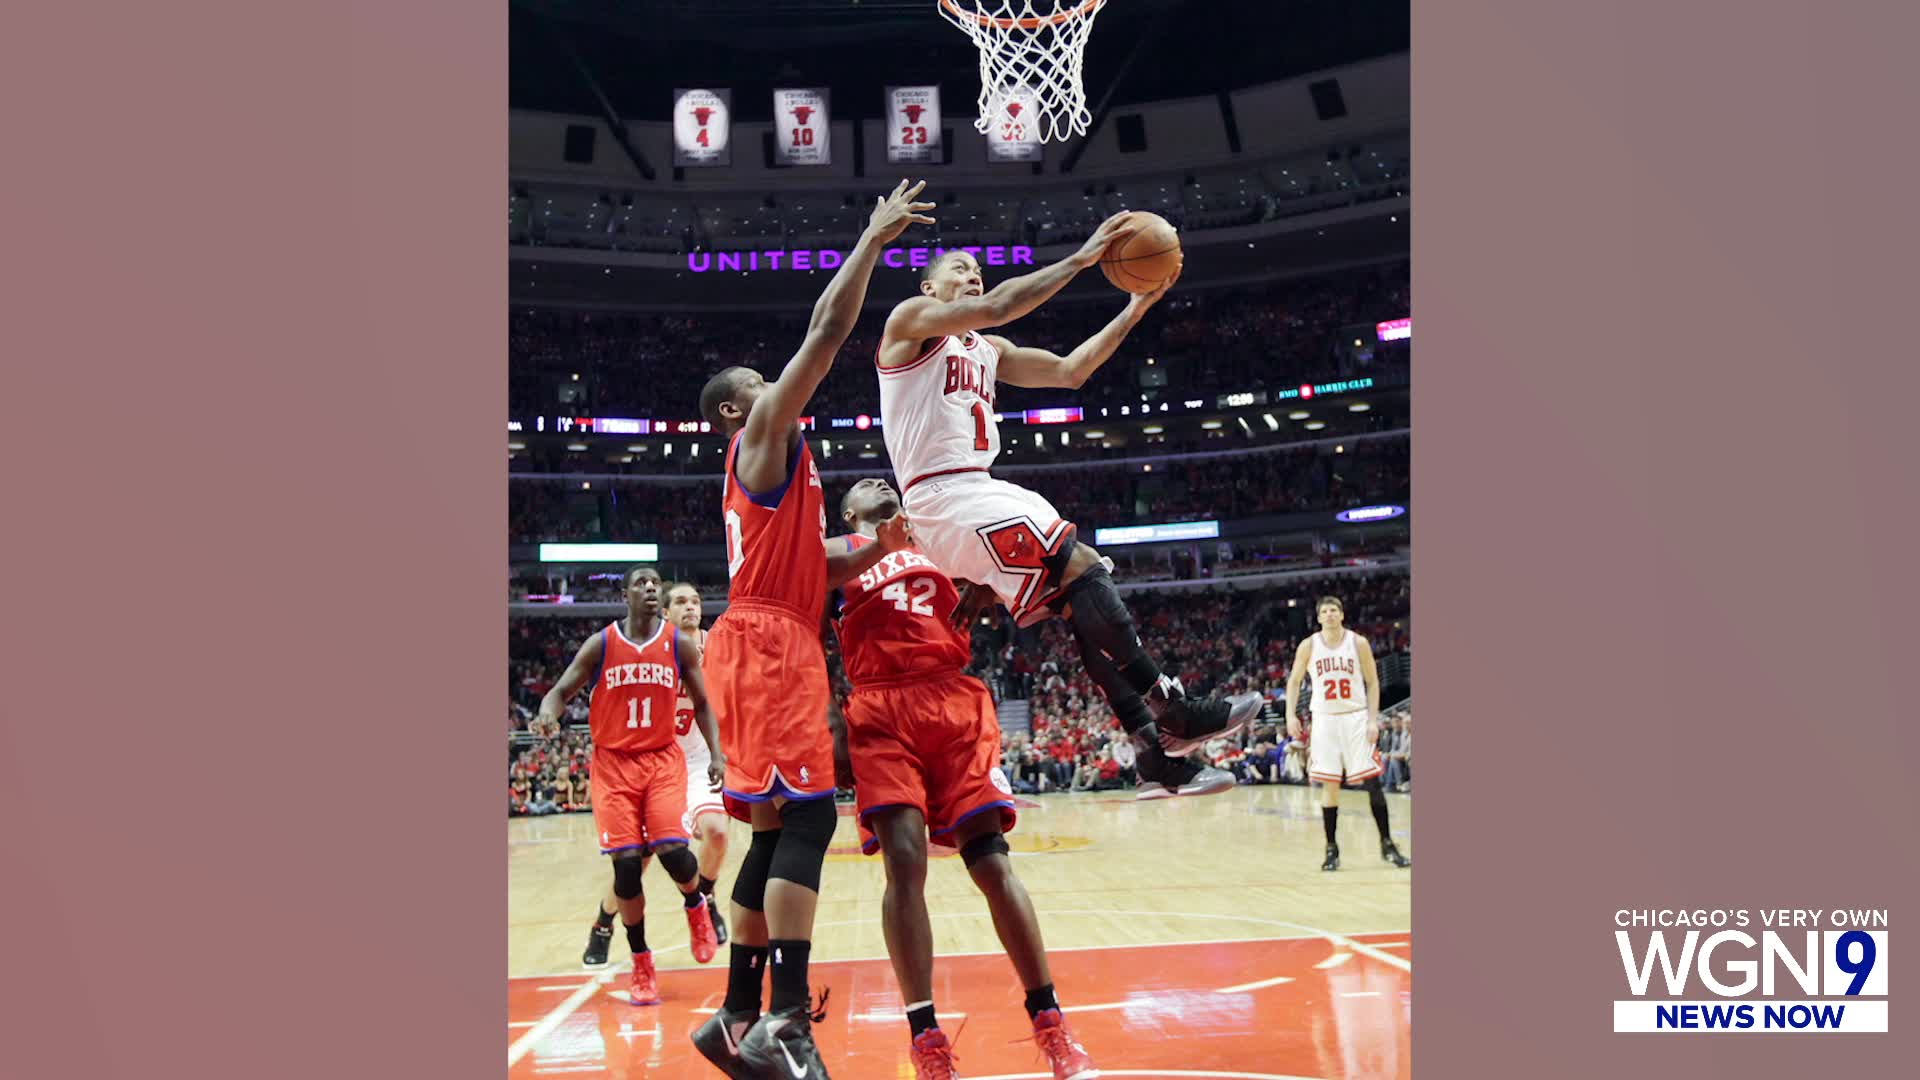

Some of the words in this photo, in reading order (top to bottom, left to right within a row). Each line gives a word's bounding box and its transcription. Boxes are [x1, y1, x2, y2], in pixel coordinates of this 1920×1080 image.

[696, 128, 709, 147] 4
[792, 128, 813, 146] 10
[902, 126, 927, 145] 23
[688, 250, 842, 272] UNITED
[884, 246, 1035, 268] CETER
[944, 356, 994, 409] BULL
[1101, 408, 1108, 416] 1
[1121, 406, 1129, 415] 2
[1142, 404, 1150, 413] 3
[1160, 403, 1168, 411] 4
[971, 402, 989, 450] 1
[882, 577, 937, 617] 42
[605, 663, 674, 690] SIXERS
[1316, 657, 1354, 676] BULLS
[1324, 679, 1352, 700] 26
[626, 697, 652, 728] 11
